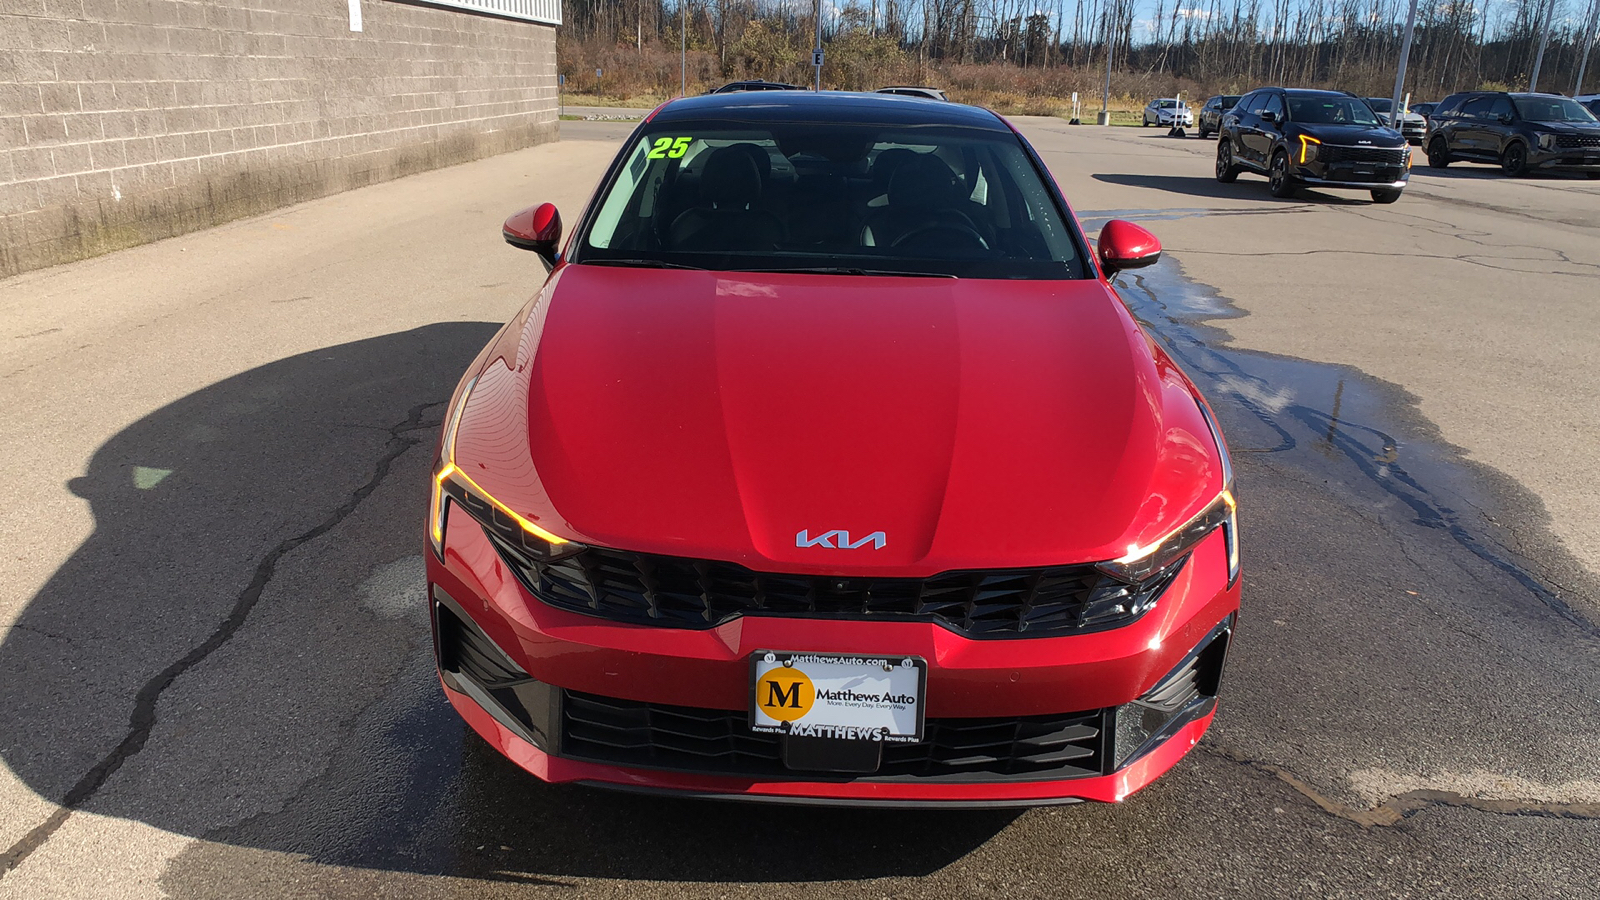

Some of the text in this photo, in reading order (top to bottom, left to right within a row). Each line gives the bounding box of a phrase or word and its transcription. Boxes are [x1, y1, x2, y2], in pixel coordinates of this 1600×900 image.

[815, 53, 821, 65] E
[647, 137, 693, 159] 25
[795, 528, 886, 550] KIA
[790, 654, 888, 667] MatthewsAuto.com
[764, 680, 804, 709] M
[816, 688, 915, 705] Matthews Auto
[845, 701, 861, 709] Every
[789, 722, 882, 742] MATTHEWS
